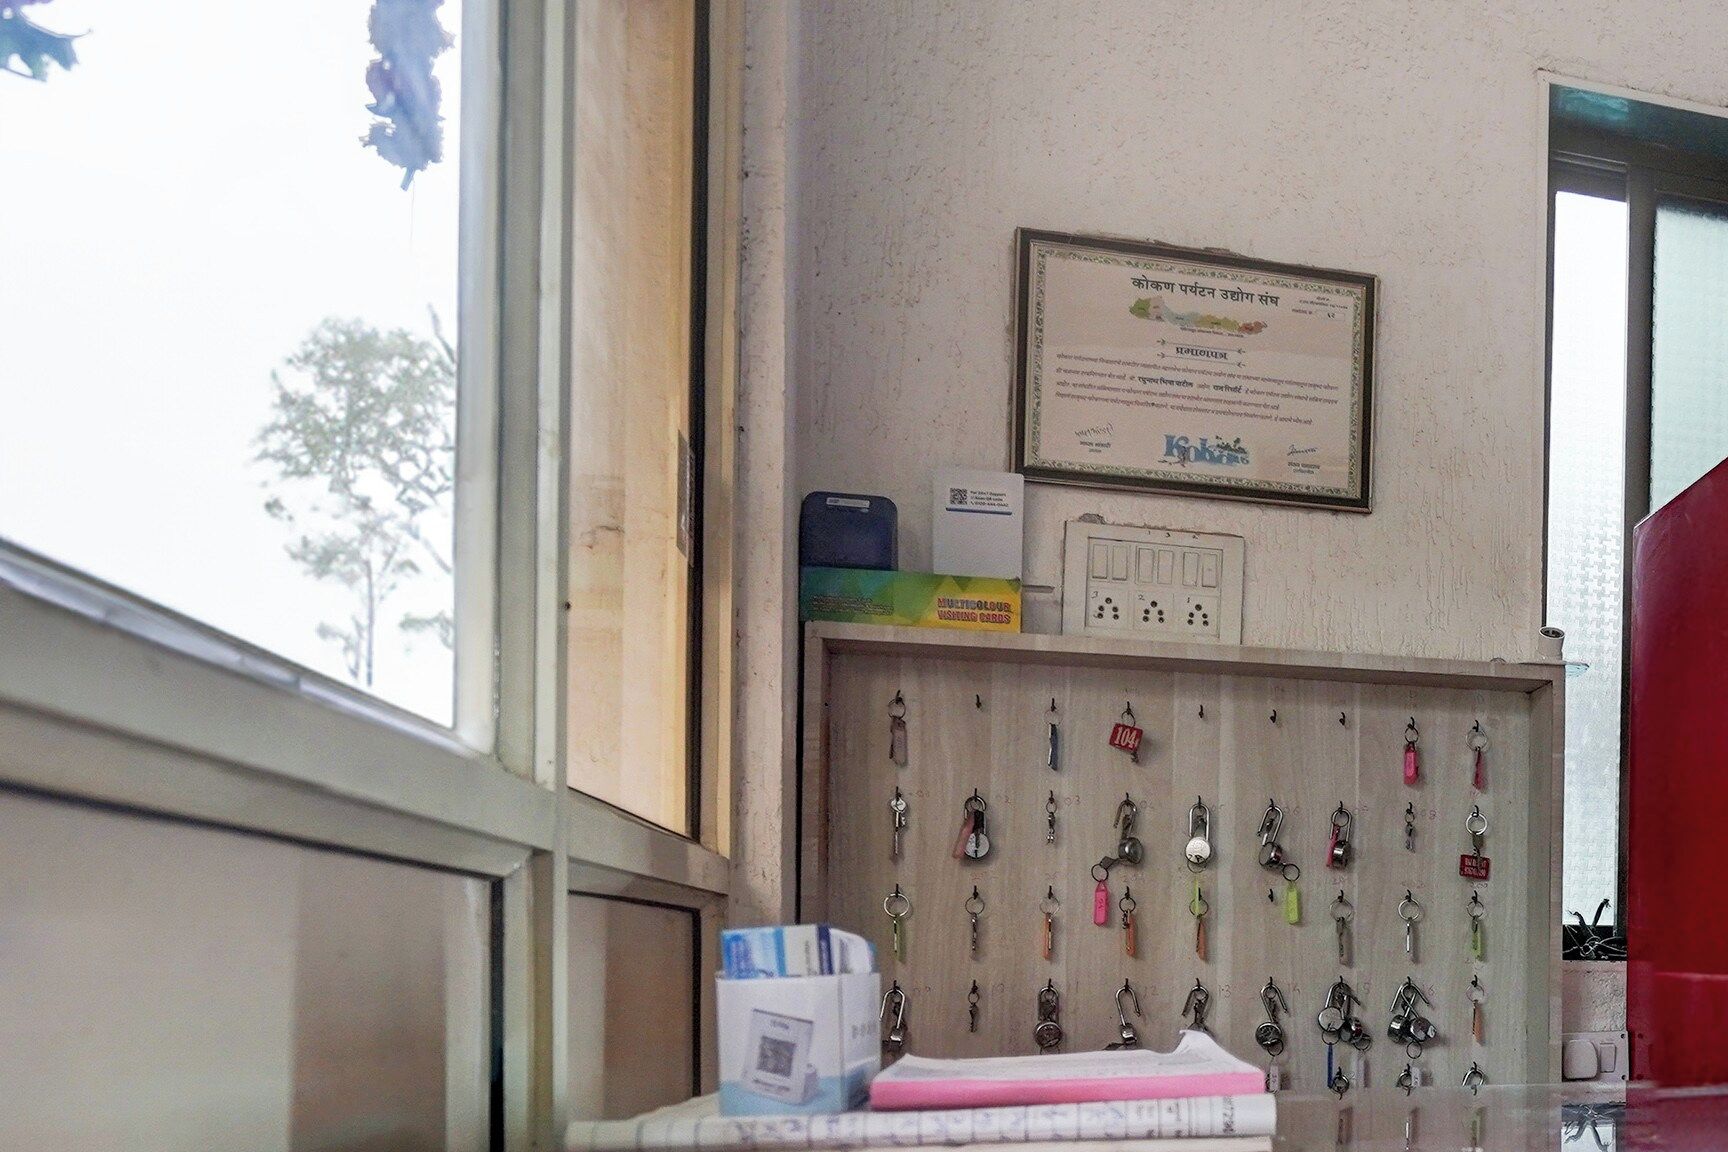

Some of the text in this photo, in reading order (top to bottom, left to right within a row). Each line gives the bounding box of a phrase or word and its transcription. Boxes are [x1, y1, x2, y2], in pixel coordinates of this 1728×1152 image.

[1131, 274, 1175, 294] कोकण
[1178, 281, 1215, 299] पर्यटन
[1220, 286, 1254, 303] उद्योग
[1258, 291, 1280, 307] संघ
[937, 597, 1012, 613] MULTICOLOUR
[937, 610, 1011, 625] VISITING CARDS
[1114, 726, 1138, 748] 104
